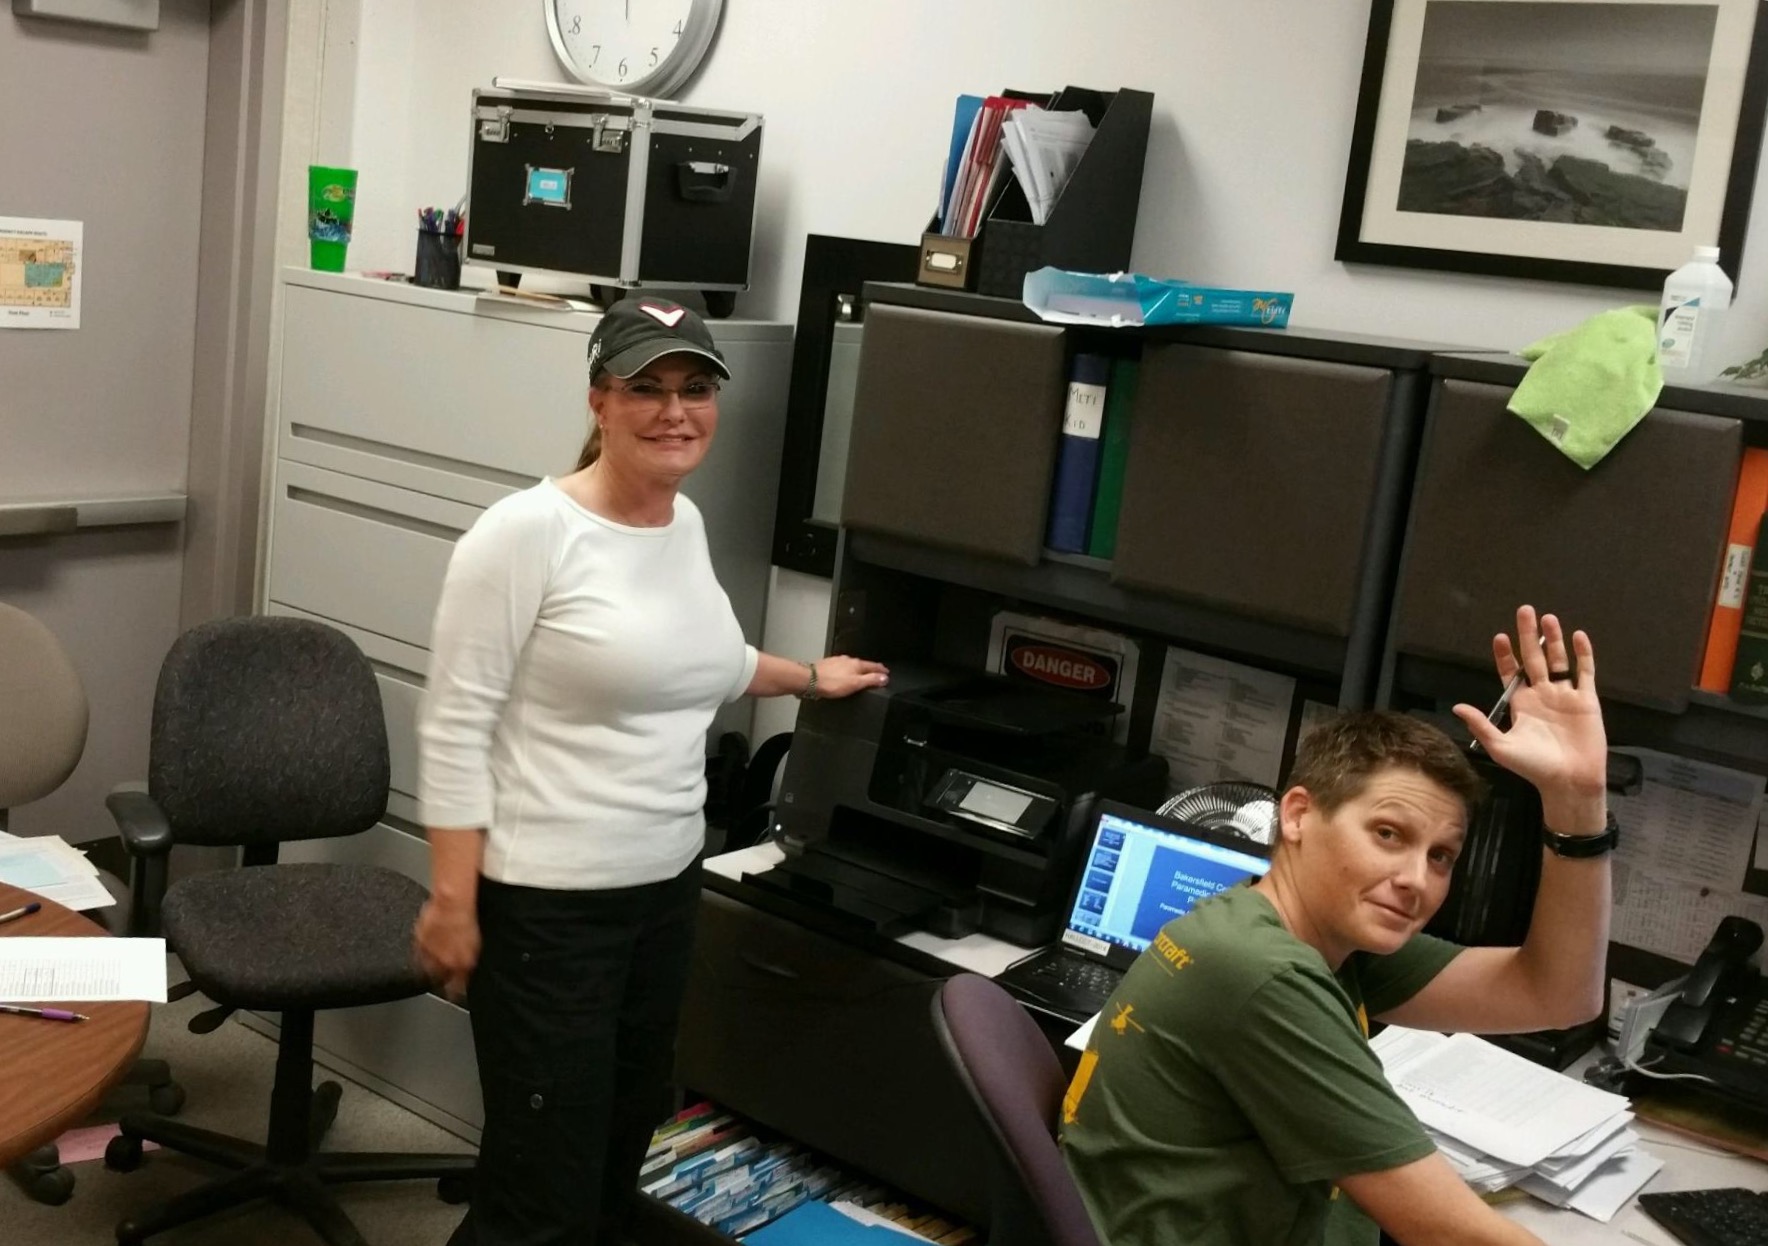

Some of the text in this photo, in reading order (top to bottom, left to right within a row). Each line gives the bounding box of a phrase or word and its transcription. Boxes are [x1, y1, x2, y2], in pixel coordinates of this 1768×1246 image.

[572, 15, 582, 35] 8
[672, 19, 683, 38] 4
[592, 45, 601, 64] 7
[648, 47, 658, 66] 5
[618, 58, 628, 77] 6
[1023, 651, 1095, 683] DANGER
[1174, 871, 1216, 890] Bakersfield
